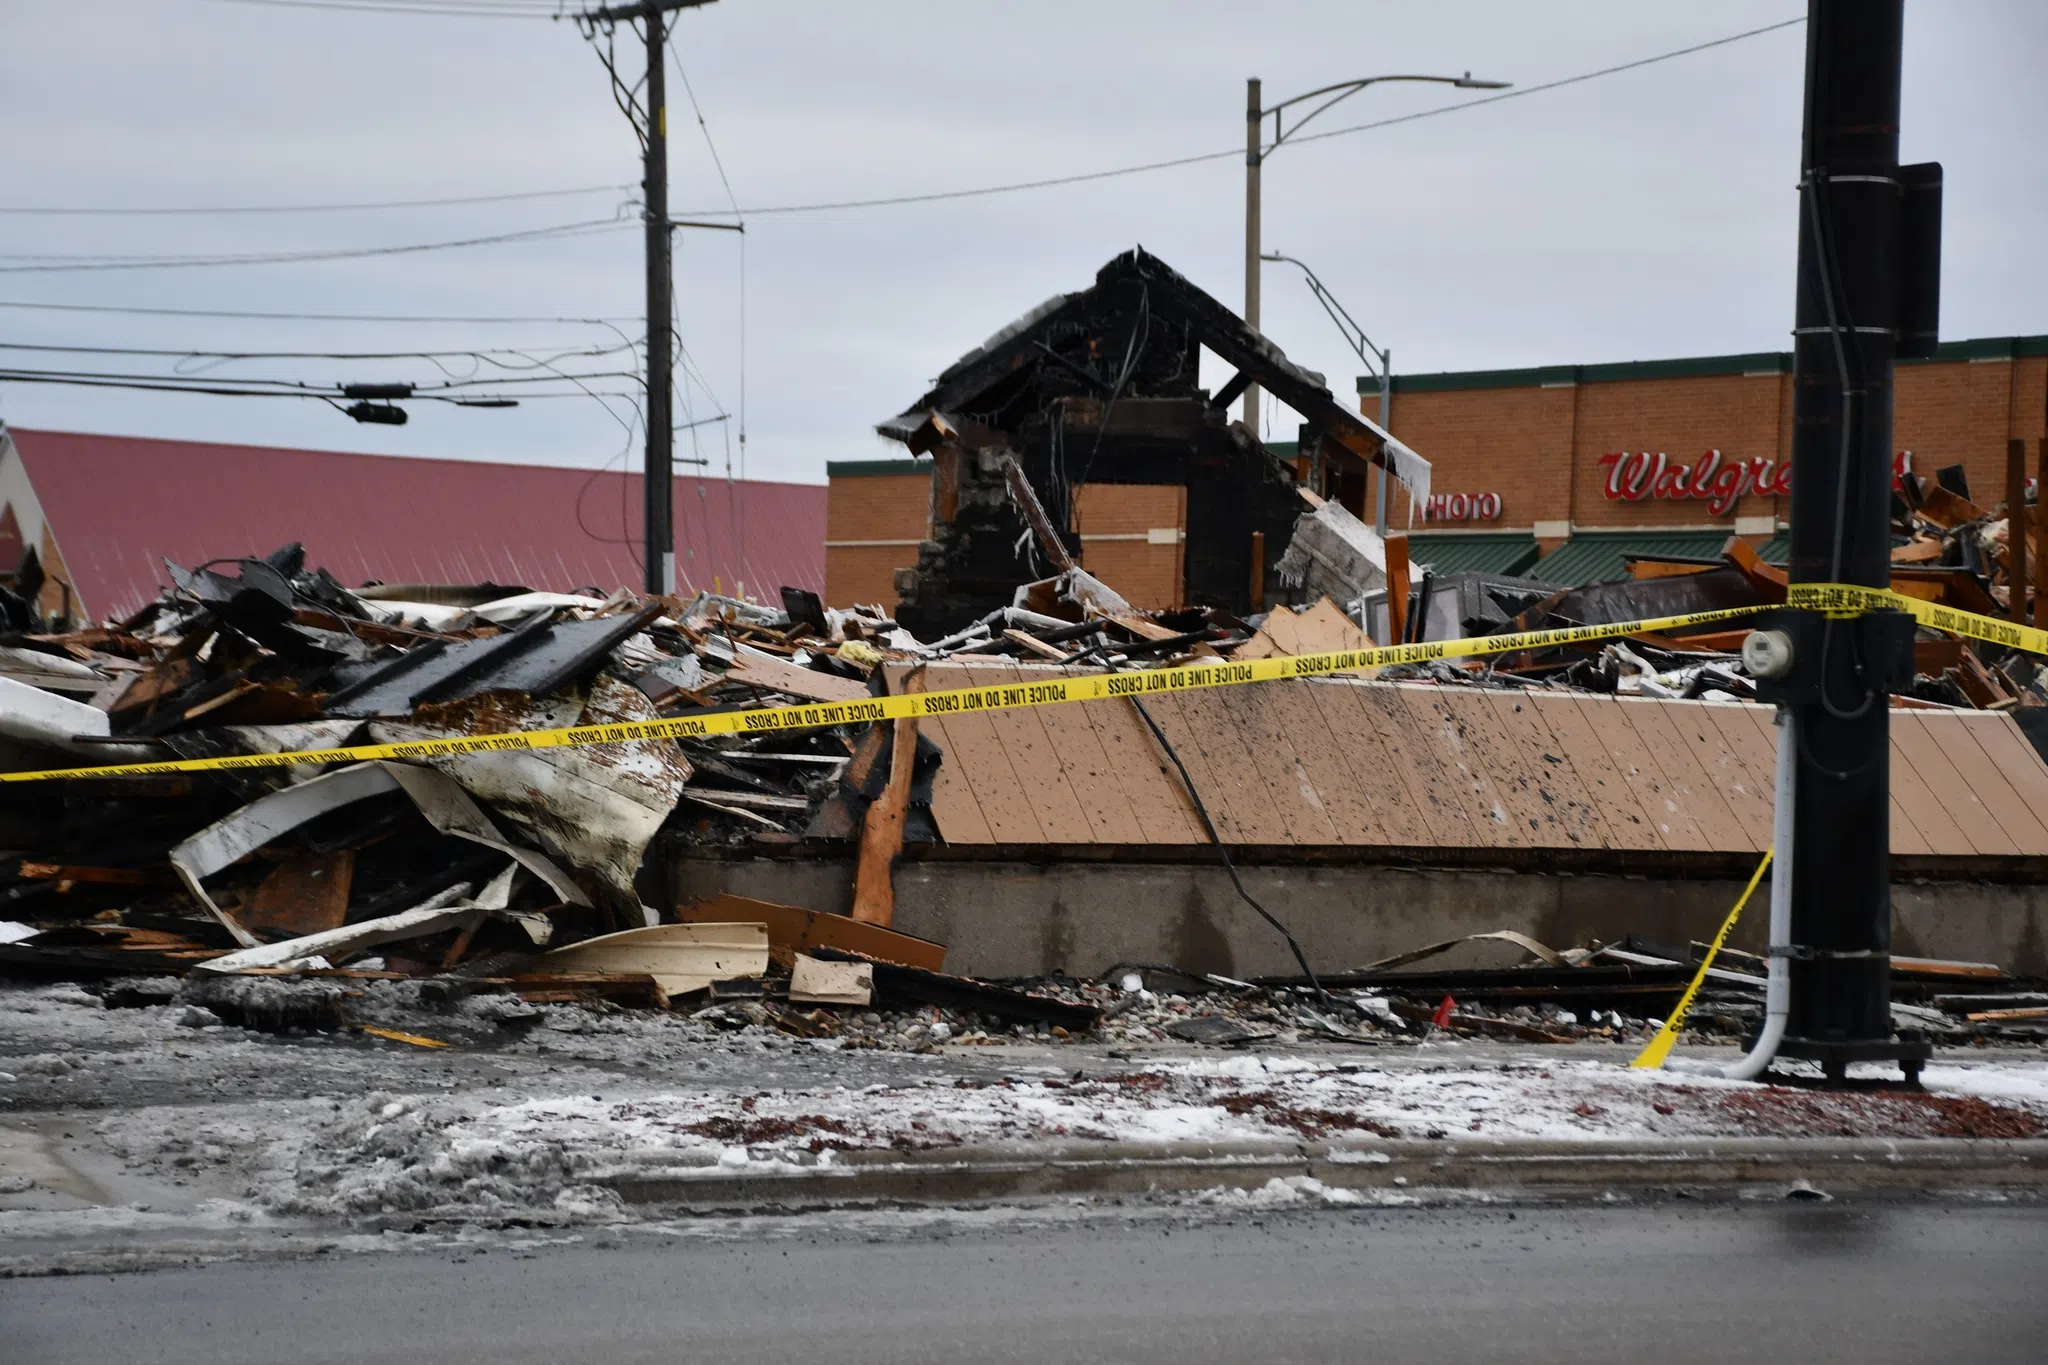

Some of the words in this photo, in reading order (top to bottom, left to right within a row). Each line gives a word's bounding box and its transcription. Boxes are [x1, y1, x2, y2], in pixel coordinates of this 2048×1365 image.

[1597, 449, 1912, 516] Walgre
[1487, 635, 1525, 650] CROSS
[1528, 632, 1550, 646] NOT
[1554, 630, 1570, 643] DO
[1358, 650, 1373, 667] DO
[1376, 647, 1401, 665] LINE
[1404, 643, 1444, 661] POLICE
[1295, 655, 1332, 674] CROSS
[1334, 652, 1356, 671] NOT
[1170, 671, 1184, 688] DO
[1188, 668, 1212, 687] LINE
[1214, 664, 1253, 683] POLICE
[1107, 675, 1143, 695] CROSS
[1146, 673, 1167, 691] NOT
[962, 693, 982, 711] NOT
[985, 691, 1000, 707] DO
[1003, 688, 1027, 707] LINE
[1029, 684, 1067, 704] POLICE
[848, 703, 885, 721] POLICE
[924, 695, 959, 713] CROSS
[745, 714, 780, 729] CROSS
[783, 712, 802, 727] NOT
[804, 710, 820, 724] DO
[822, 707, 846, 723] LINE
[567, 728, 603, 744] CROSS
[605, 728, 625, 742] NOT
[627, 726, 644, 740] DO
[645, 724, 668, 739] LINE
[669, 721, 706, 736] POLICE
[428, 744, 450, 756] NOT
[450, 743, 467, 754] DO
[467, 740, 492, 752] LINE
[491, 736, 531, 749] POLICE
[391, 746, 428, 758] CROSS
